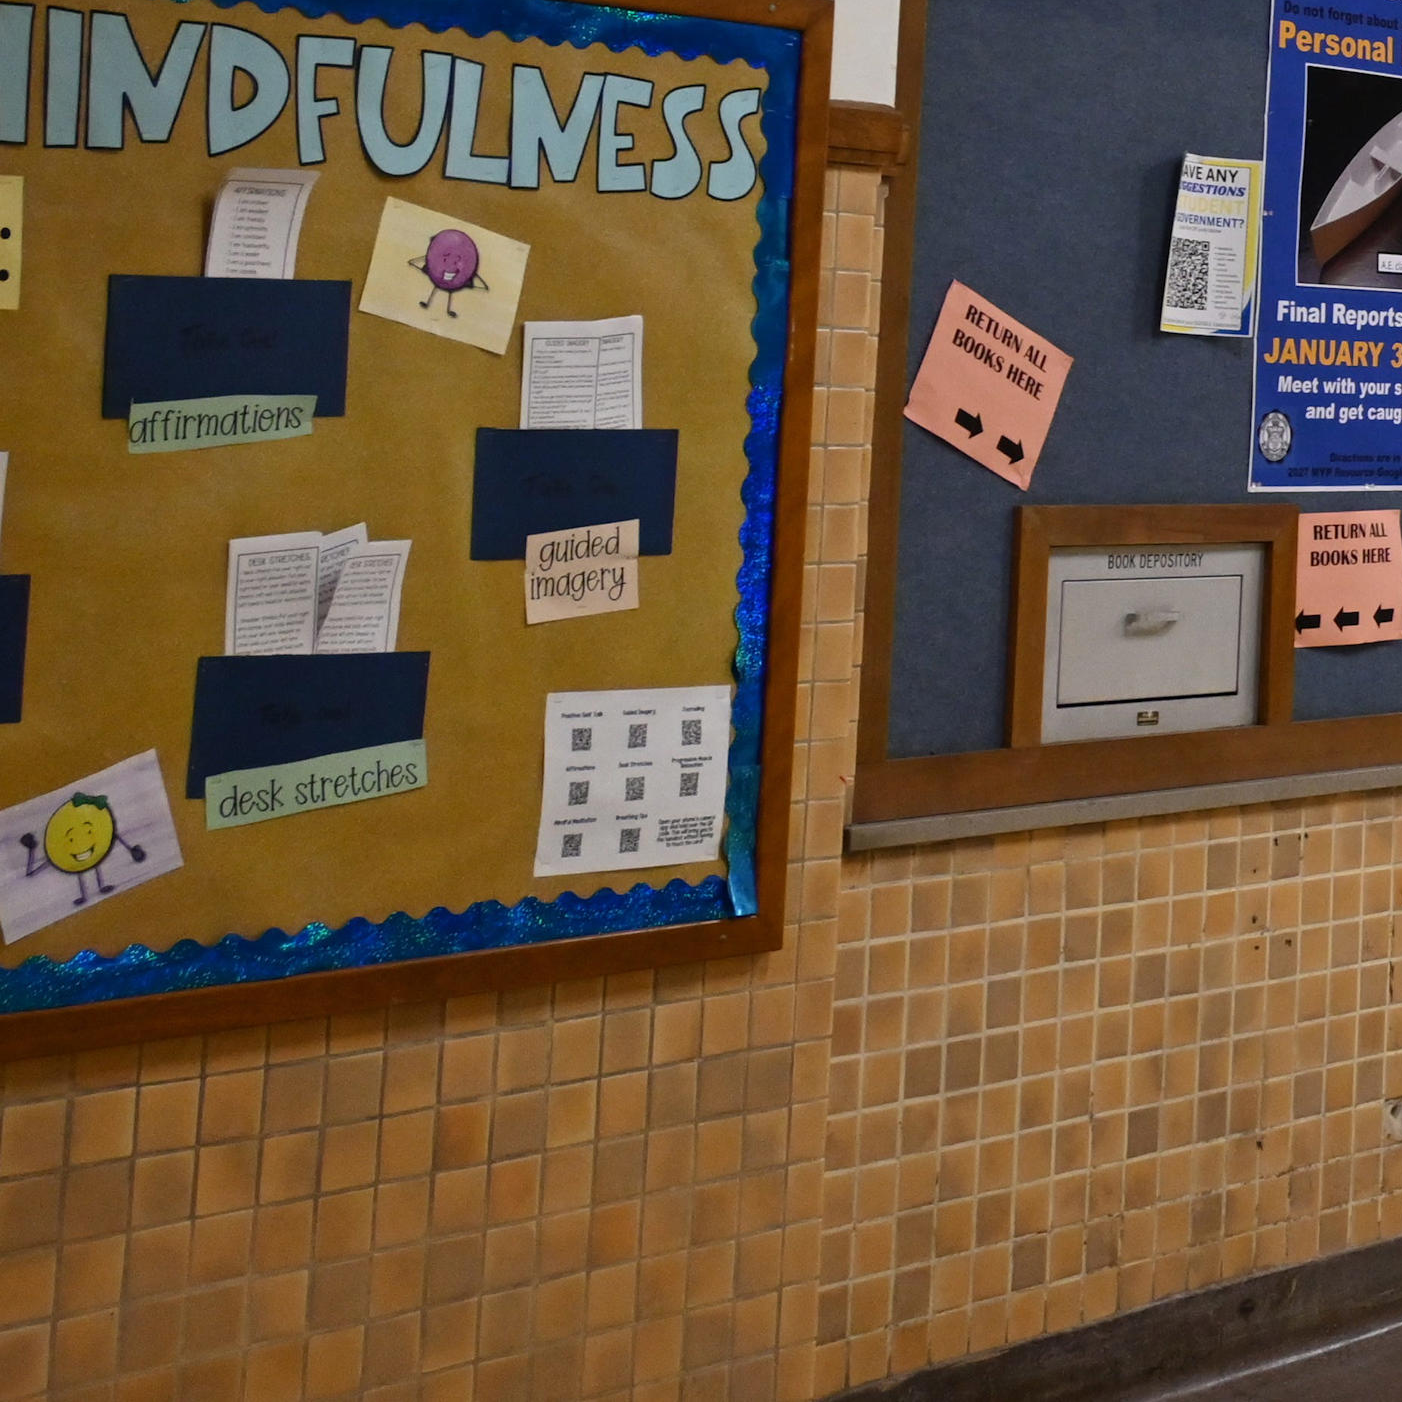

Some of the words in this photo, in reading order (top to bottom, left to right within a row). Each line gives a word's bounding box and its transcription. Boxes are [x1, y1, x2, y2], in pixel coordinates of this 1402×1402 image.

[1278, 19, 1394, 64] Personal
[1205, 168, 1240, 185] ANY
[1276, 300, 1327, 324] Final
[964, 303, 1024, 355] RETURN
[1022, 339, 1049, 374] ALL
[1263, 337, 1385, 368] JANUARY
[951, 328, 1005, 374] BOOKS
[1005, 361, 1045, 402] HERE
[1277, 375, 1320, 395] Meet
[1322, 376, 1357, 396] with
[1358, 381, 1392, 399] your
[127, 402, 305, 447] affirmations
[1304, 402, 1336, 421] and
[1338, 405, 1365, 425] get
[1311, 522, 1367, 542] RETURN
[1368, 521, 1389, 538] ALL
[539, 527, 622, 574] guided
[1107, 554, 1137, 571] BOOK
[1138, 552, 1204, 570] DEPOSITORY
[1309, 548, 1360, 567] BOOKS
[1362, 547, 1392, 565] HERE
[528, 560, 627, 604] imagery
[218, 782, 286, 821] desk
[294, 759, 419, 808] stretches
